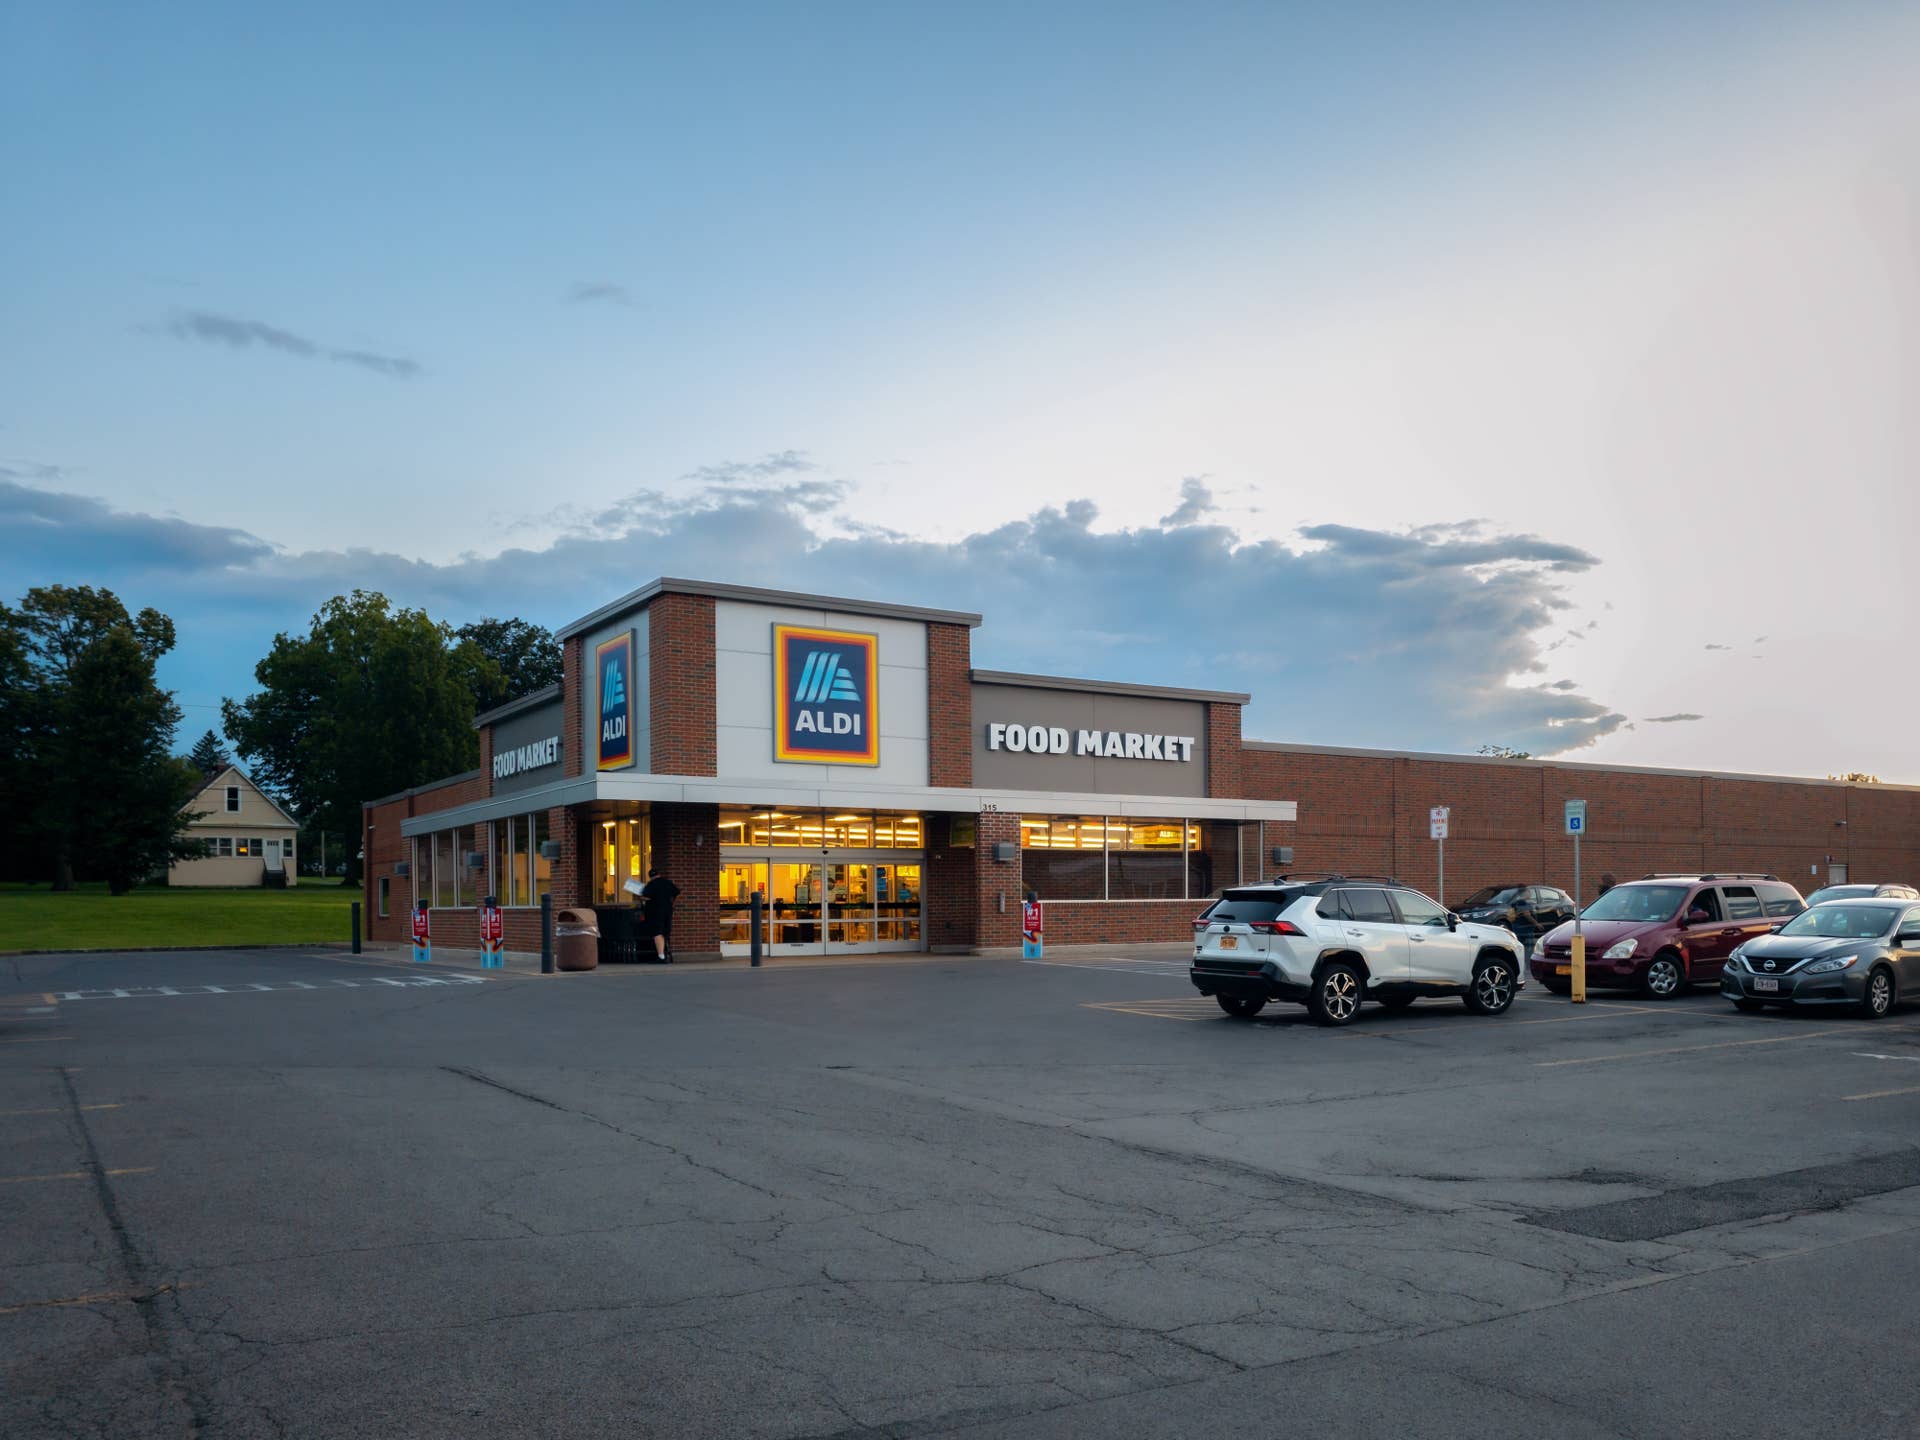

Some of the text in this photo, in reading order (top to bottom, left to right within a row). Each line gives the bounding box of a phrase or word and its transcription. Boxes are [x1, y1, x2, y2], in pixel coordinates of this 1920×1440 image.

[602, 715, 626, 742] ALDI
[795, 709, 861, 735] ALDI
[989, 722, 1195, 761] FOOD MARKET
[493, 735, 558, 779] FOOD MARKET
[982, 803, 997, 811] 315
